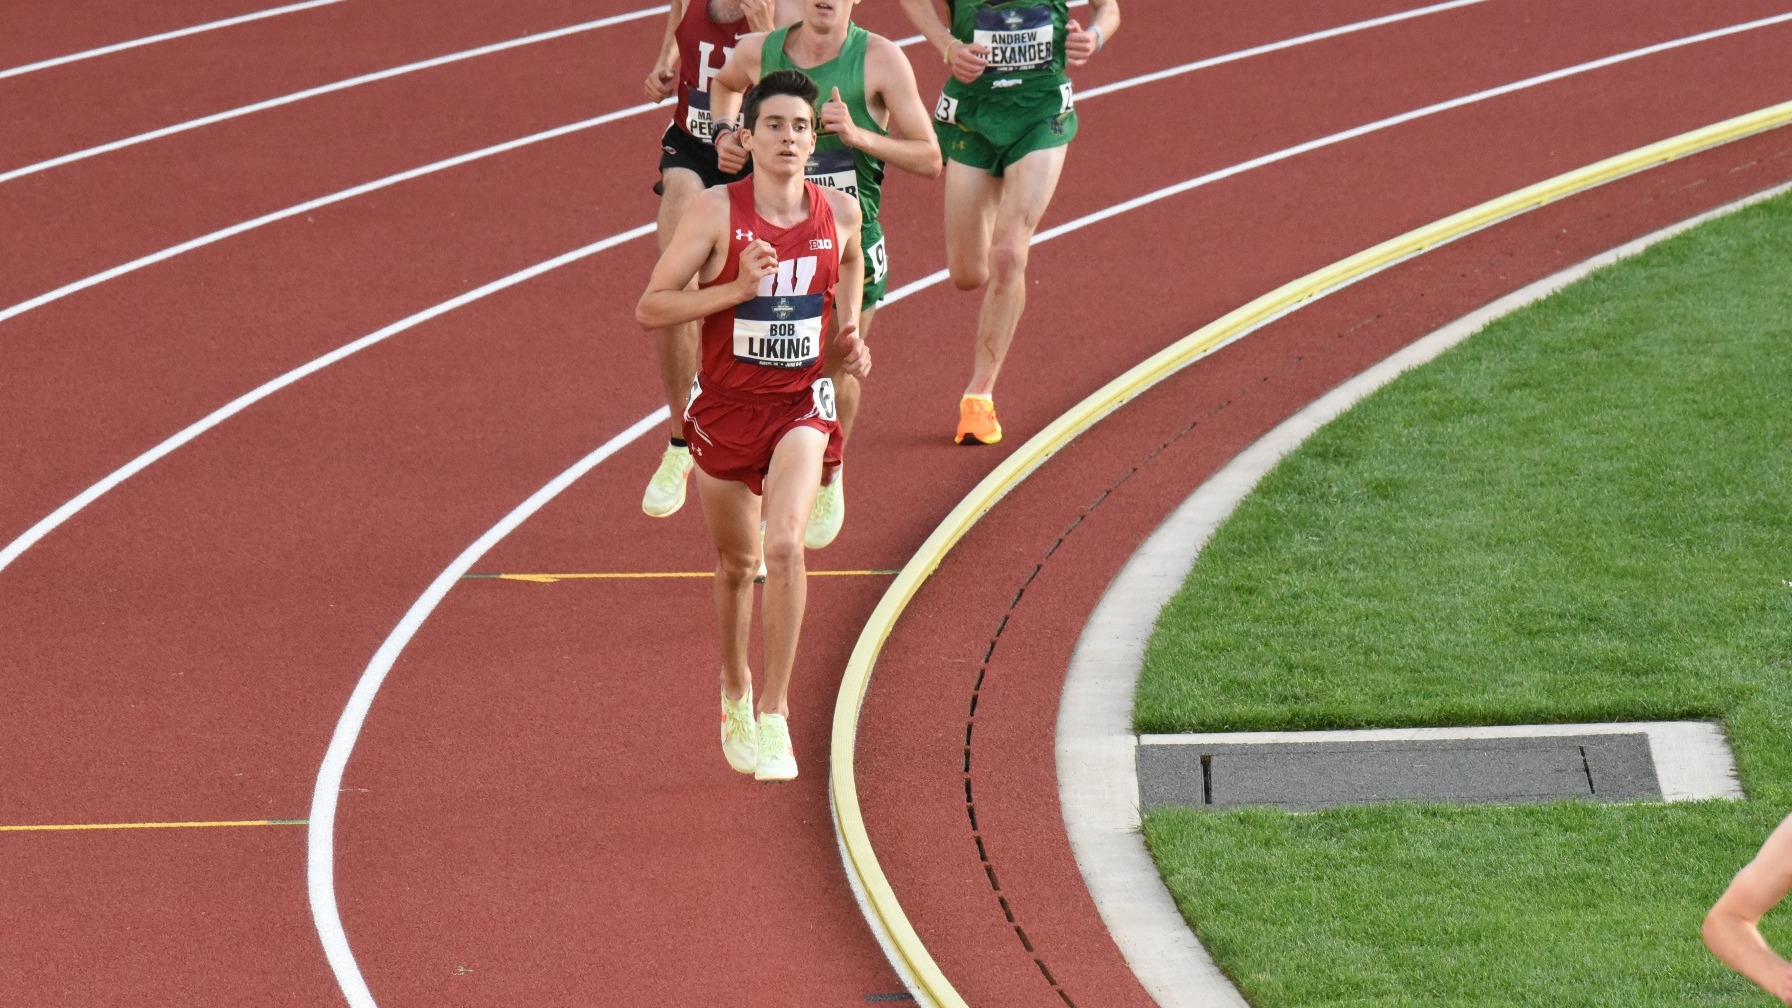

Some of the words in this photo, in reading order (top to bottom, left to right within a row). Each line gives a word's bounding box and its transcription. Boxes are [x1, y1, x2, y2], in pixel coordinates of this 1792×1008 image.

[992, 32, 1037, 45] ANDREW
[769, 323, 795, 337] BOB
[748, 336, 811, 360] LIKING
